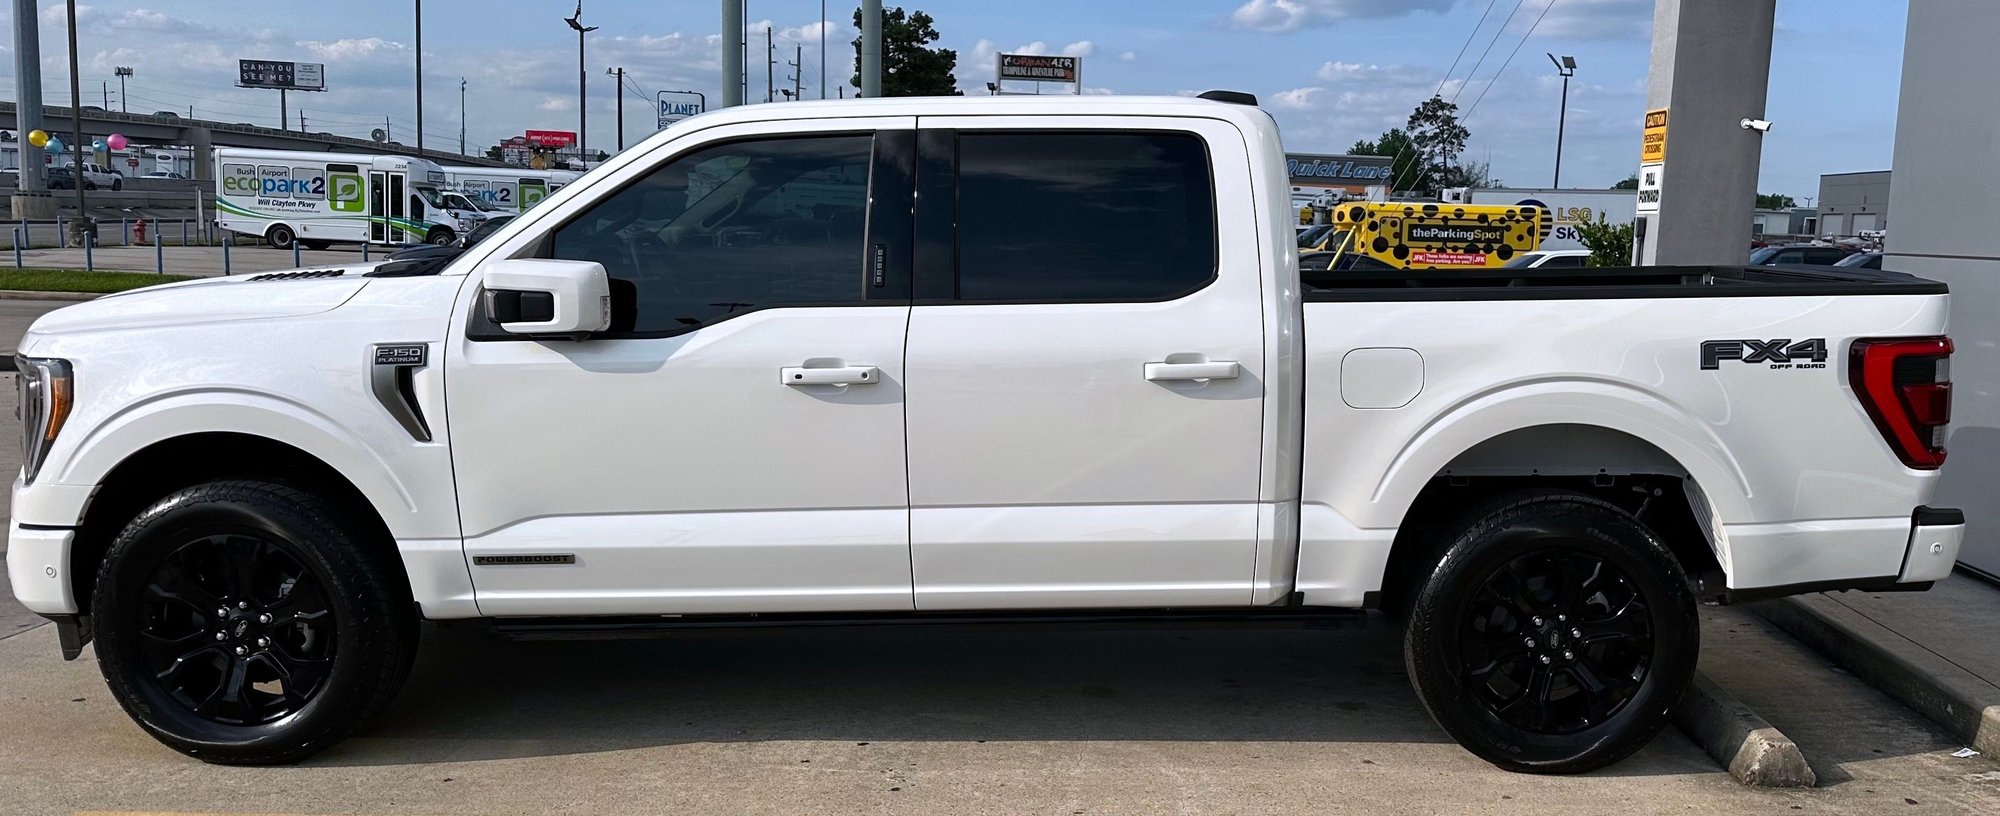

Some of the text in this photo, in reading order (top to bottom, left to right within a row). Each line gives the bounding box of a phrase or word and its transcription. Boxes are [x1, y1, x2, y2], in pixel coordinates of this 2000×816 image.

[242, 63, 292, 72] CAN YOU
[1012, 57, 1072, 68] URBAN AIR
[243, 73, 292, 82] SEE ME?
[661, 100, 699, 116] PLANET
[1646, 112, 1666, 127] CAUTION
[1644, 132, 1664, 144] PEDESTRIAN
[1644, 144, 1662, 154] CROSSING
[236, 168, 288, 177] Bush Airport
[1286, 159, 1393, 179] Quick Lane
[465, 181, 486, 189] Airport
[1645, 172, 1656, 186] PULL
[223, 176, 325, 195] ecopark2
[1638, 189, 1659, 204] FORWARD
[271, 199, 297, 208] Clayton
[297, 200, 316, 209] Pkwy
[1557, 207, 1592, 221] LSG
[1412, 228, 1500, 240] theParkingSpot
[376, 348, 421, 357] F-150
[1699, 338, 1828, 370] FX4
[476, 555, 571, 563] POWERBOOST
